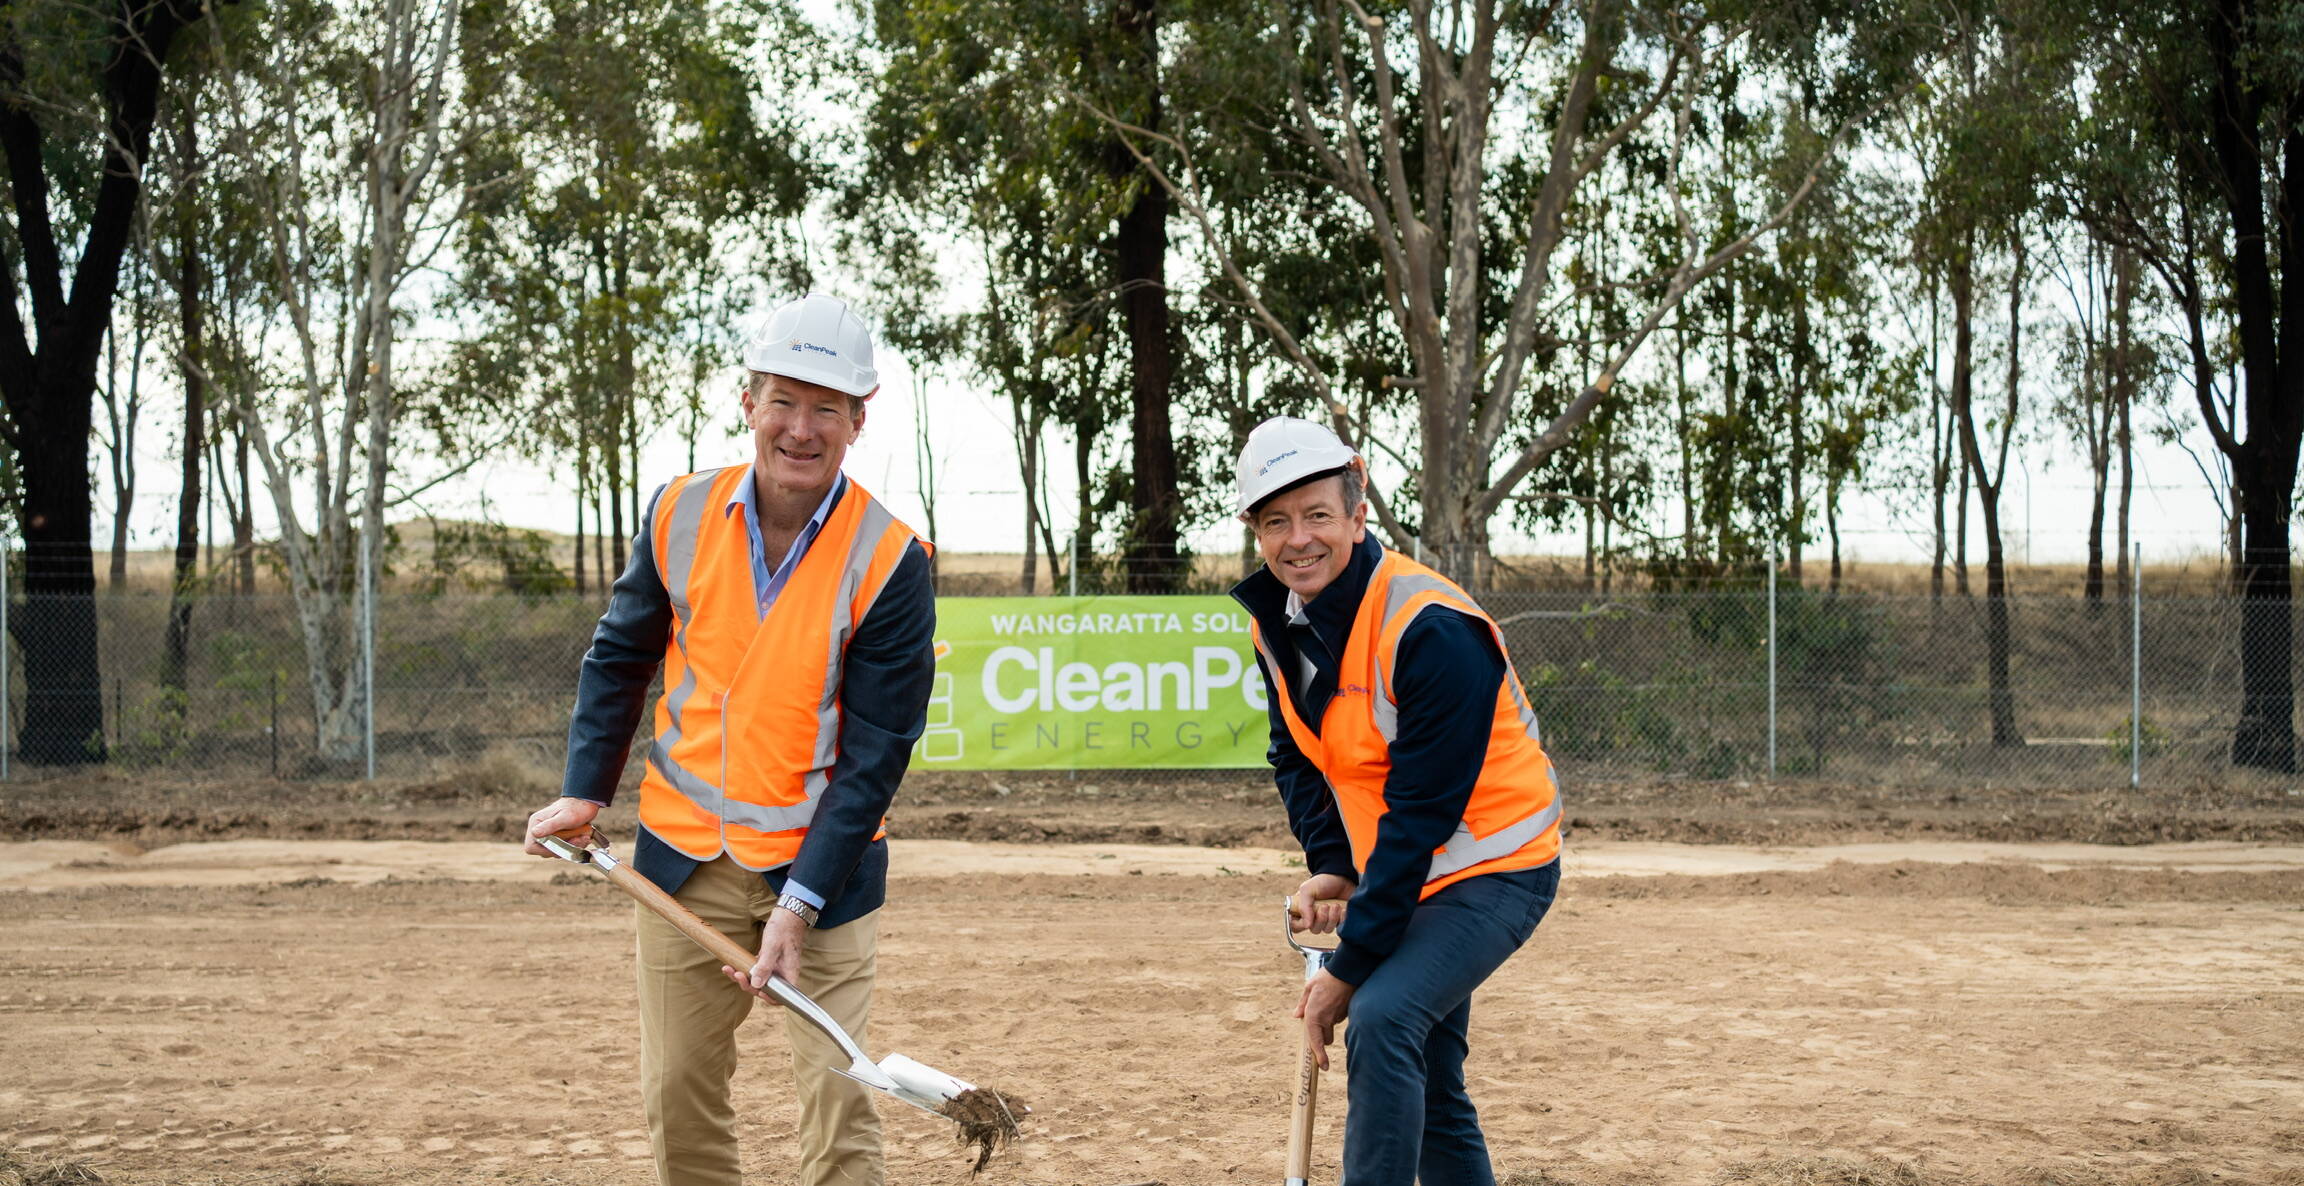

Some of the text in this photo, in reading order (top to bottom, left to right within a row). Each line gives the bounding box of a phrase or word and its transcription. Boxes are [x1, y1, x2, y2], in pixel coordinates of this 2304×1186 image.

[804, 343, 837, 356] CleanPeak
[991, 613, 1183, 635] WANGARATTA
[991, 721, 1246, 749] ENERGY
